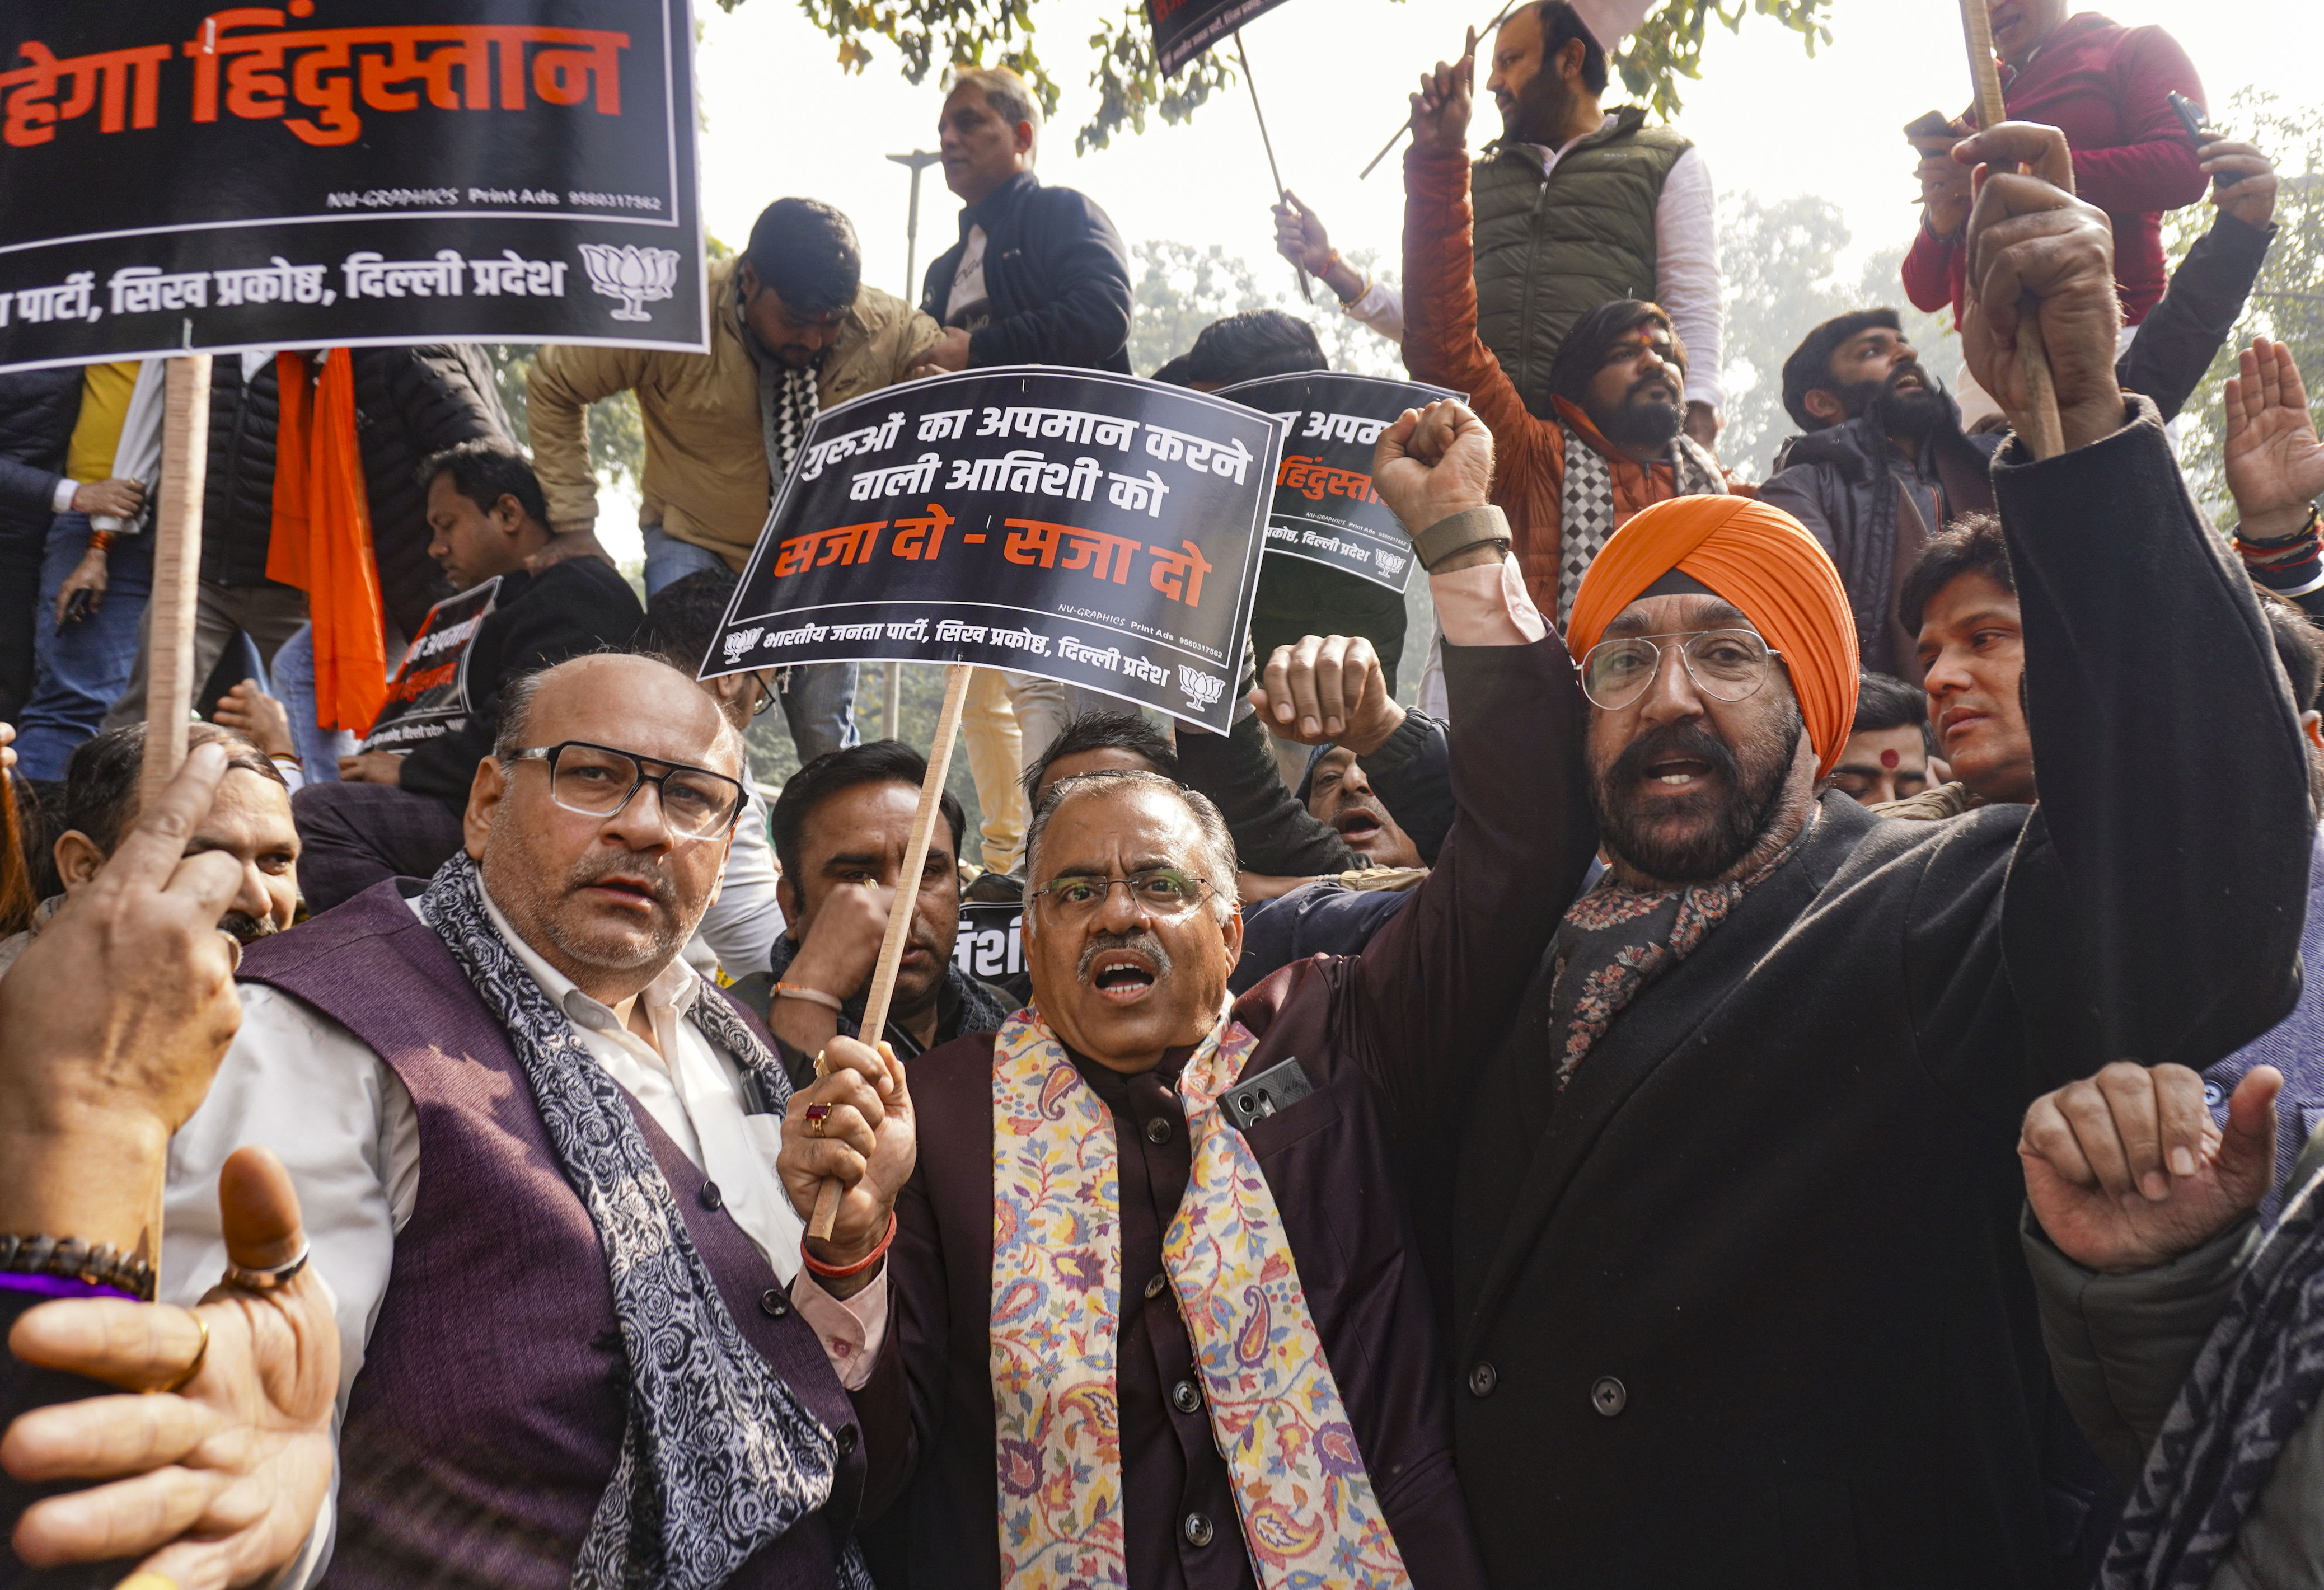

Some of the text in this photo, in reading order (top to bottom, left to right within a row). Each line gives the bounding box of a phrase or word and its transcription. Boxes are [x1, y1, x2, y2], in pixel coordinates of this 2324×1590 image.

[0, 0, 630, 147] हेगा हिंदुस्तान
[468, 187, 518, 204] Print
[519, 188, 559, 205] Ads
[16, 271, 103, 323] पार्टी,
[107, 266, 212, 314] सिख
[213, 256, 337, 306] प्रकोष्ठ,
[341, 249, 467, 298] दिल्ली
[468, 249, 568, 297] प्रदेश
[800, 411, 906, 482] गुरुओं
[917, 409, 973, 442] का
[976, 407, 1140, 452] अपमान
[1145, 424, 1254, 486] करने
[1302, 411, 1395, 444] अपम
[849, 449, 1170, 518] वाली आतिशी को
[774, 520, 888, 578] सजा
[891, 503, 955, 560] दो
[1004, 518, 1142, 585] सजा
[1149, 539, 1212, 608] दो
[1301, 530, 1341, 552] दिल्ली
[1341, 543, 1371, 562] प्रदेश
[1306, 512, 1346, 526] NU-GRAPHICS
[1348, 522, 1364, 531] Print
[1364, 526, 1376, 534] Ads
[763, 618, 1171, 687] भारतीय जनता पार्टी, सिख प्रकोष्ठ, दिल्ली प्रदेश
[1058, 603, 1223, 659] NU-GRAPHICS Print Ads 9560317562
